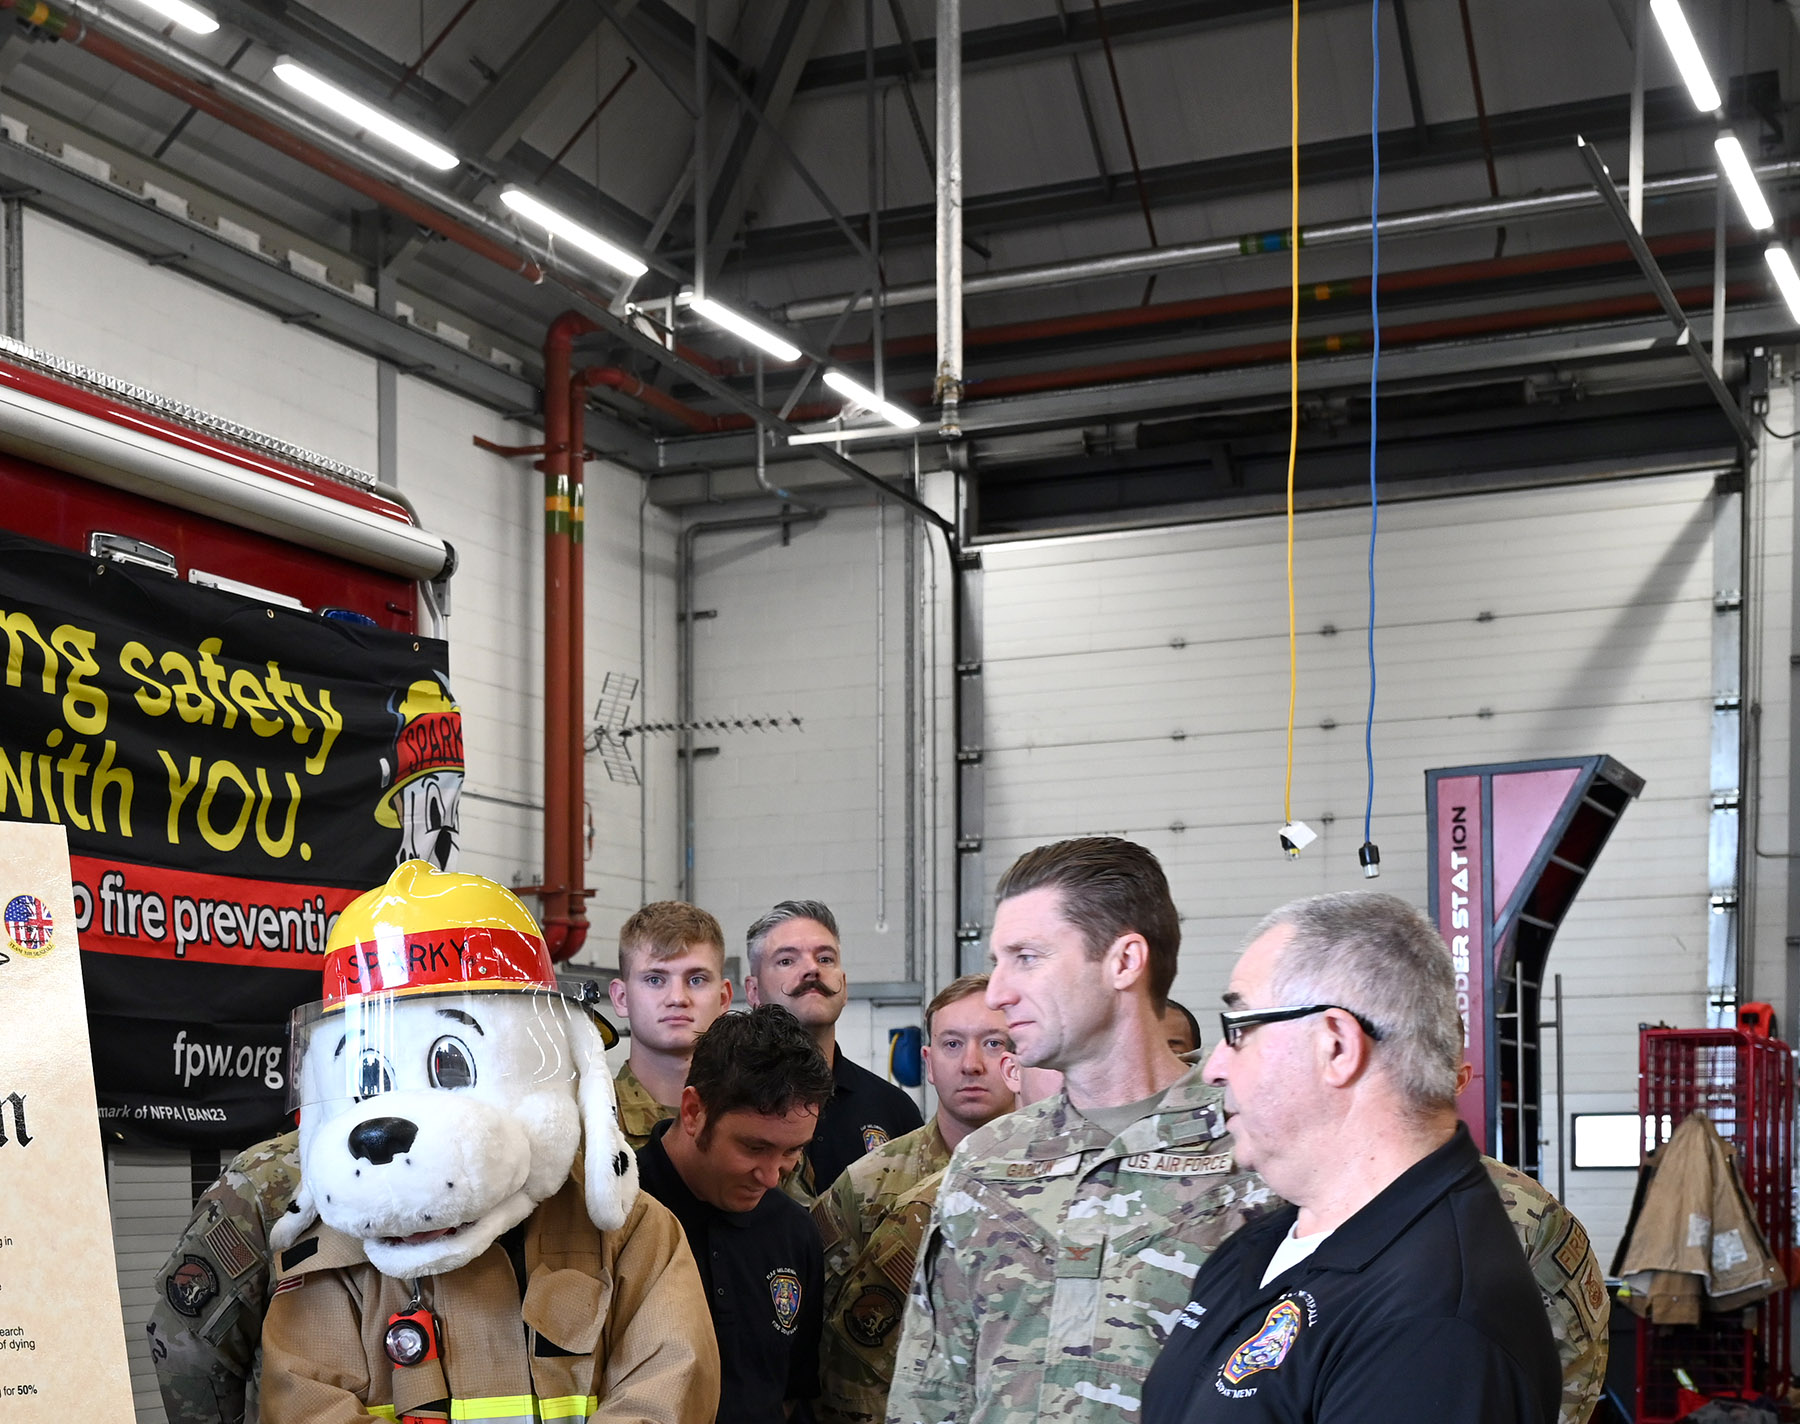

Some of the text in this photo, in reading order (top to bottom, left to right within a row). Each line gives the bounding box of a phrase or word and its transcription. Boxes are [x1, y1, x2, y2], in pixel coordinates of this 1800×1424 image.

[119, 637, 343, 775] safety
[405, 716, 464, 768] SPARK
[157, 749, 312, 862] YOU.
[1451, 806, 1469, 930] STATION
[72, 873, 341, 955] o fire preventi
[172, 1030, 284, 1090] fpw.org
[98, 1104, 131, 1119] mark
[134, 1105, 149, 1120] of
[1127, 1153, 1227, 1172] U.S. AIR FORCE
[3, 1235, 14, 1247] in
[1560, 1226, 1588, 1272] FIRE
